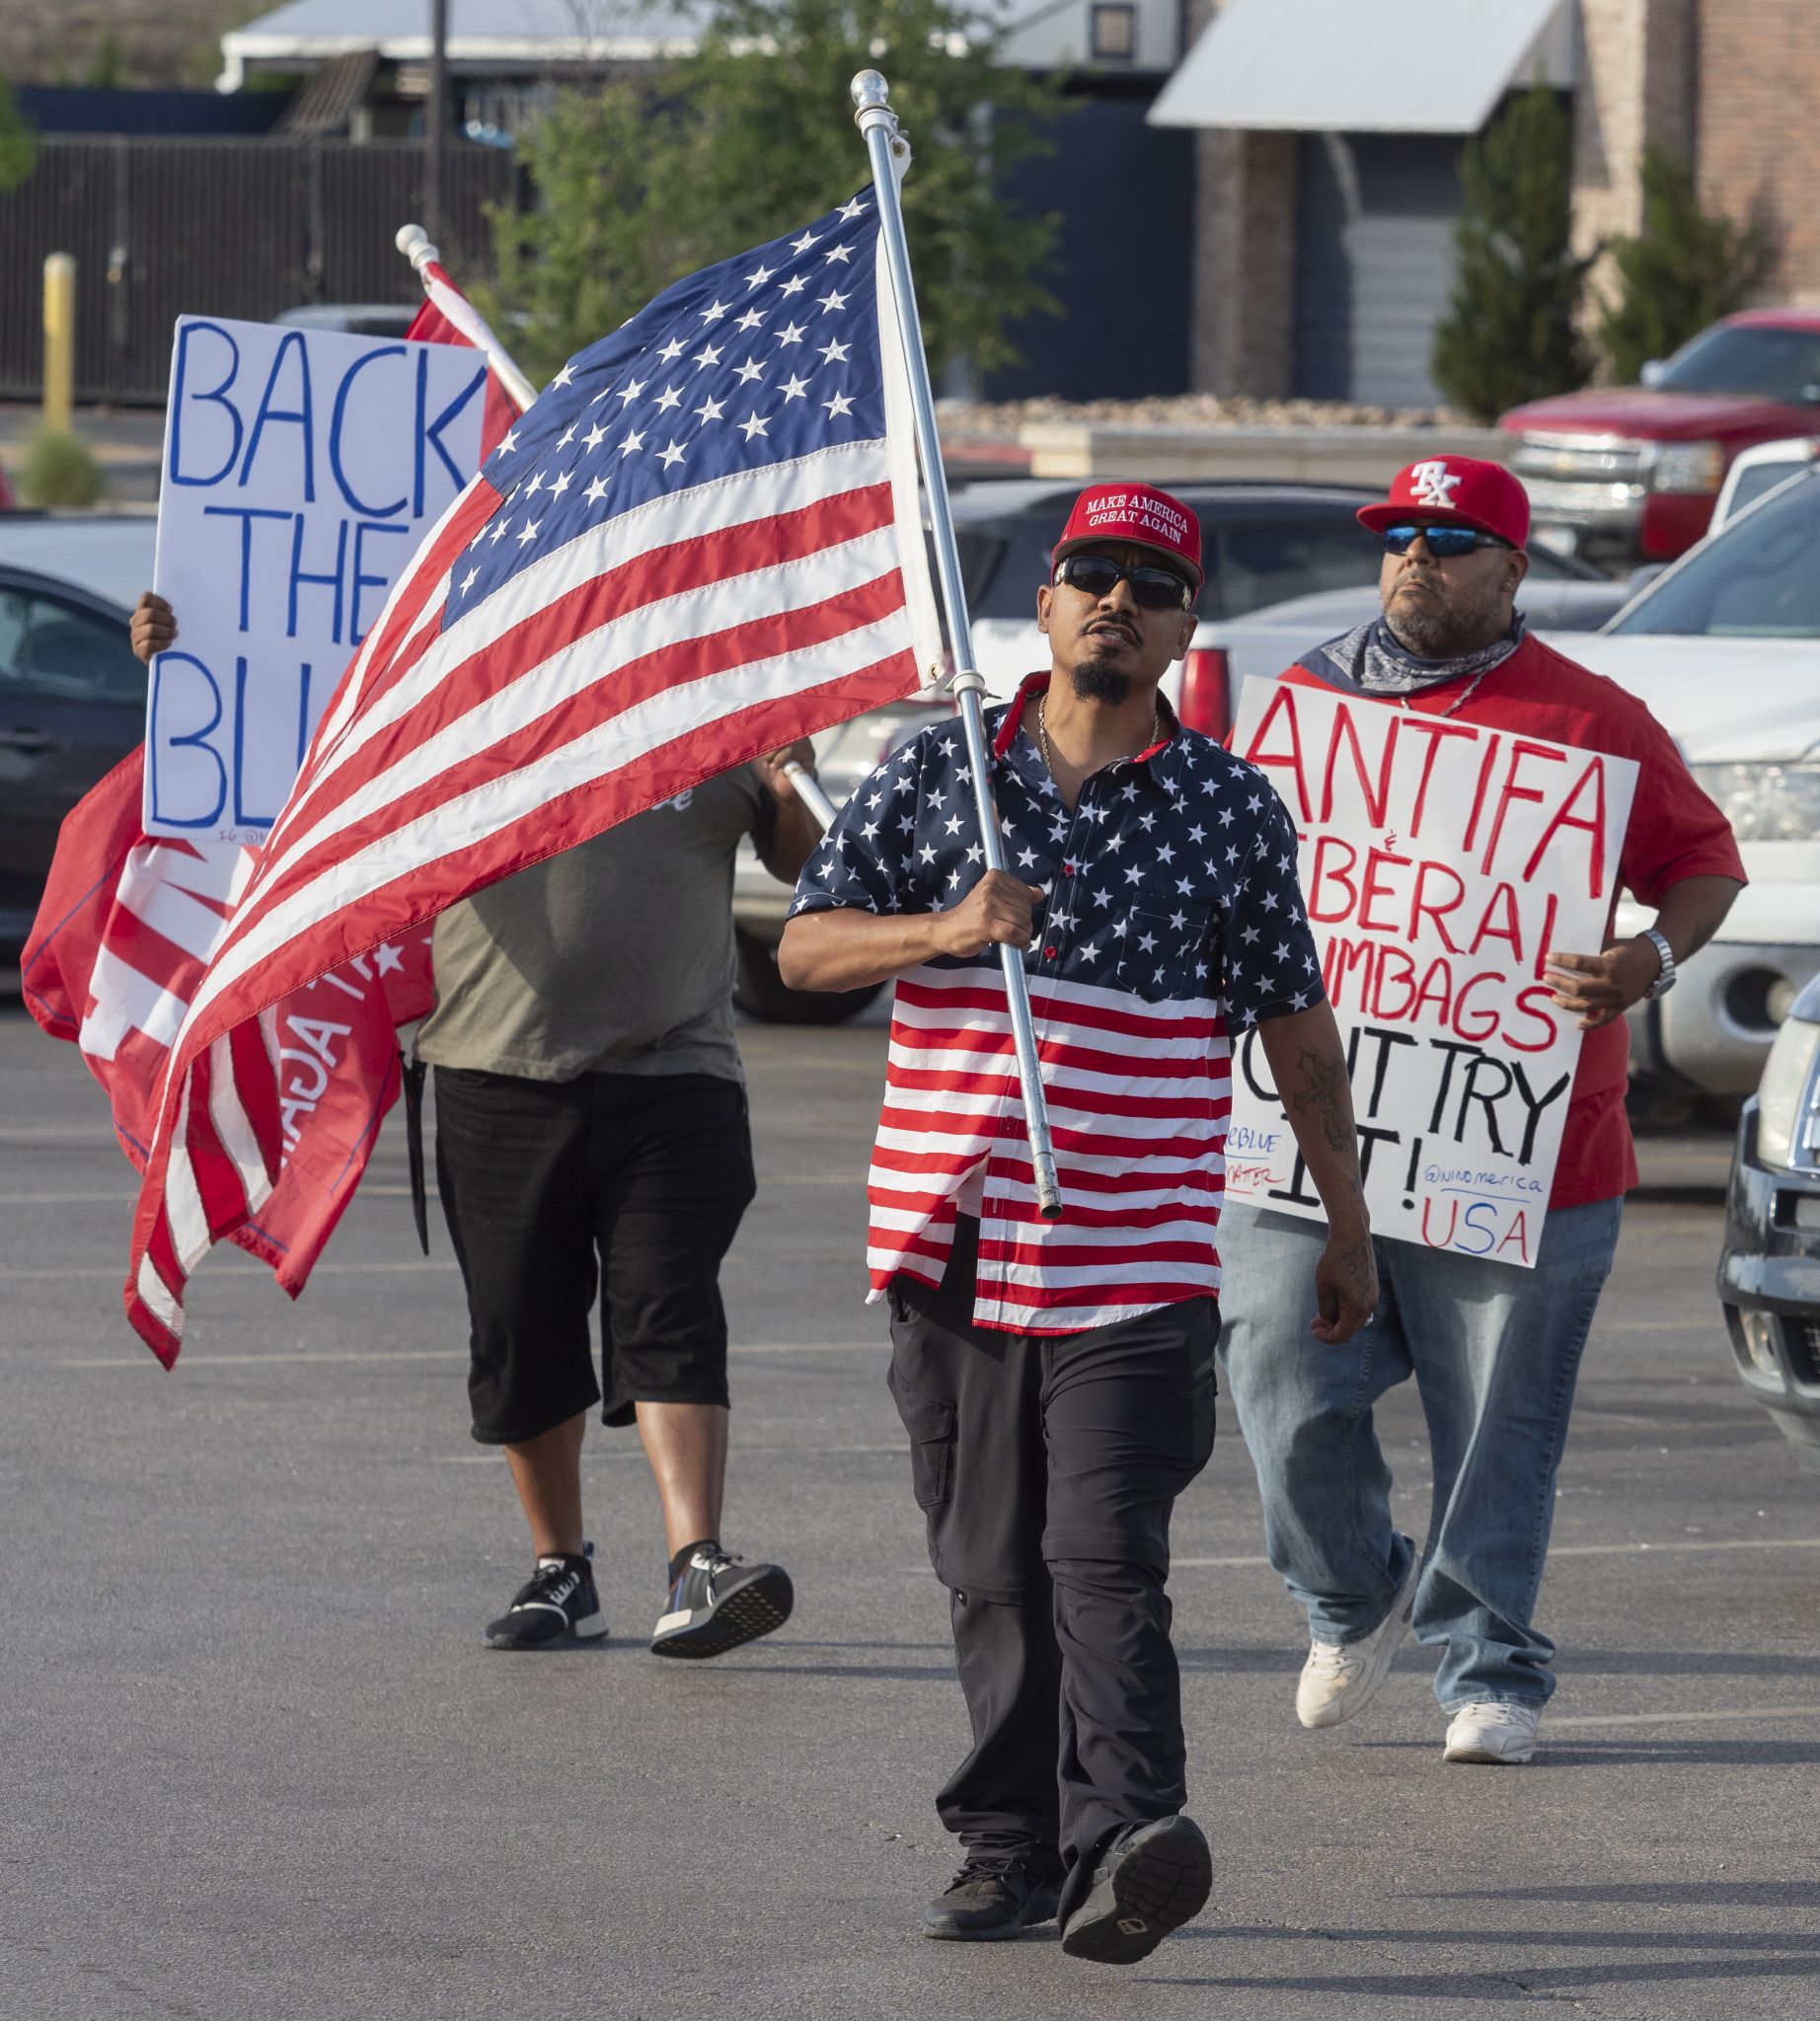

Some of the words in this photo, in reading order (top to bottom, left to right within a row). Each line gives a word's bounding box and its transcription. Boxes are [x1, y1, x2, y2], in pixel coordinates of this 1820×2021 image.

[170, 322, 488, 518] BACK
[203, 506, 409, 645] THE
[1086, 494, 1127, 514] MAKE
[1129, 494, 1188, 534] AMERICA
[1089, 509, 1138, 527] GREAT
[1139, 514, 1181, 545] AGAIN
[1246, 686, 1607, 899] ANTIFA
[1298, 832, 1557, 980] BERAL
[1428, 1038, 1570, 1165] TRY
[1421, 1196, 1529, 1263] USA
